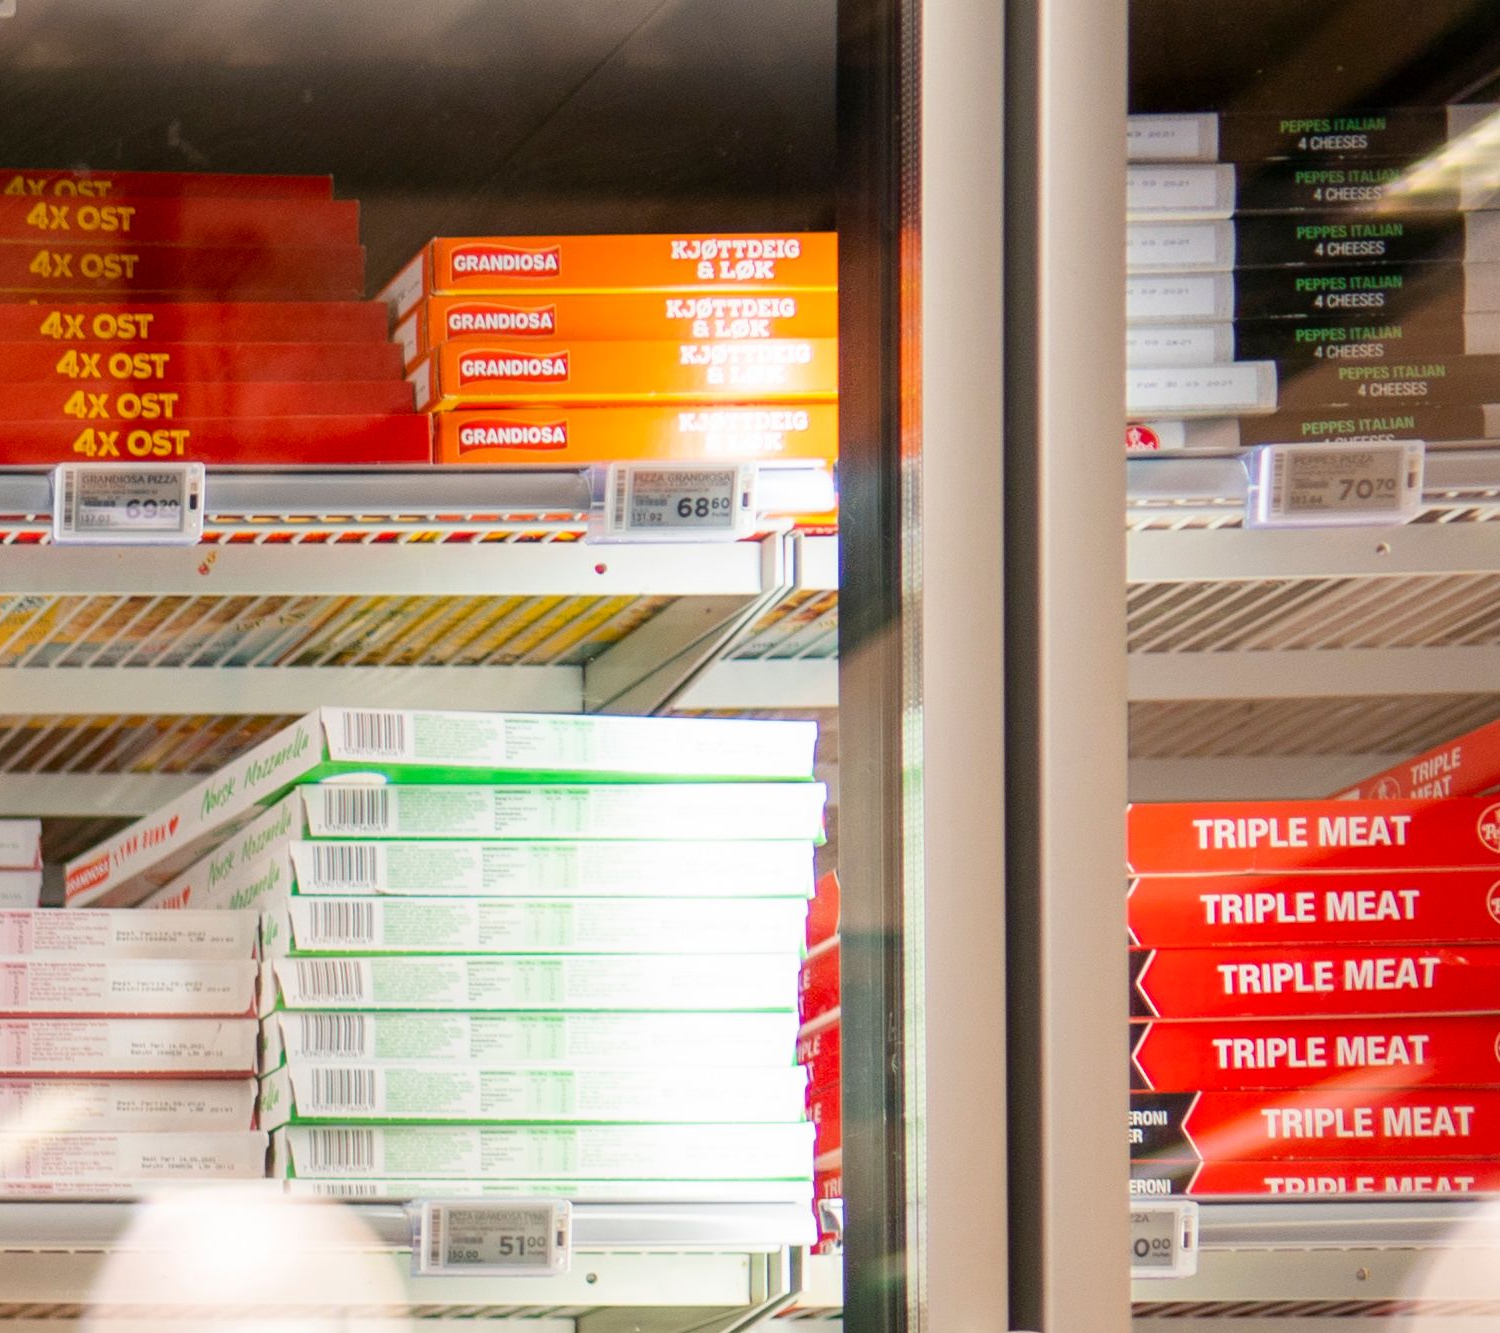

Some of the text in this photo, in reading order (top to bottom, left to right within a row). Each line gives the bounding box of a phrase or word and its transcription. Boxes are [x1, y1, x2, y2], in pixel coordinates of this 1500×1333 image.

[1296, 224, 1403, 239] PEPPES ITALIAN
[671, 239, 801, 261] KJØTTDEIG
[1315, 241, 1385, 256] 4 CHEESES
[453, 252, 558, 272] GRANDIOSA
[697, 261, 775, 280] & LØK
[73, 430, 190, 457] 4X OST
[1193, 815, 1411, 849] TRIPLE MEAT
